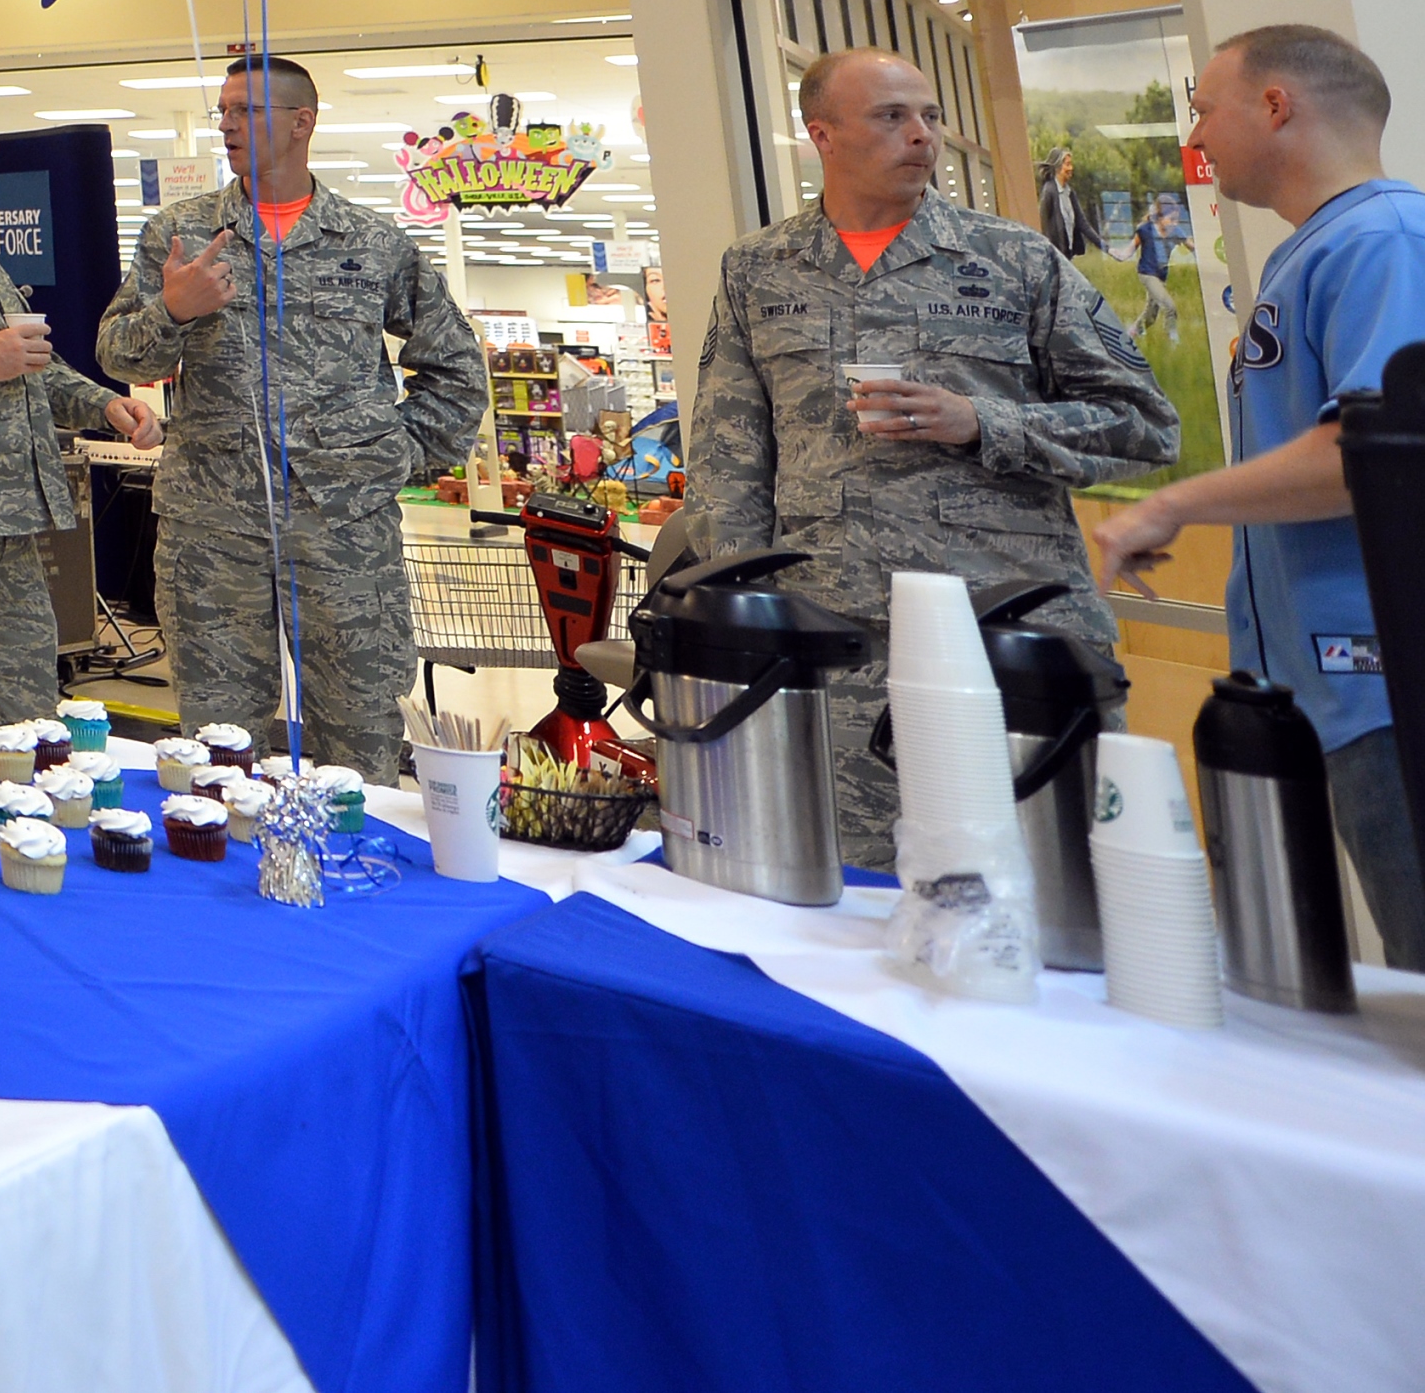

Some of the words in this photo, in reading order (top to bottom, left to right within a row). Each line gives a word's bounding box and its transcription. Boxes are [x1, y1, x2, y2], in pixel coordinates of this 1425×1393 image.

[412, 158, 586, 202] HALLOWEEN
[338, 276, 352, 287] AIR
[355, 278, 380, 292] FORCE
[760, 303, 808, 318] SWISTAK
[927, 302, 953, 316] U.S.
[956, 304, 981, 318] AIR
[984, 307, 1023, 325] FORCE
